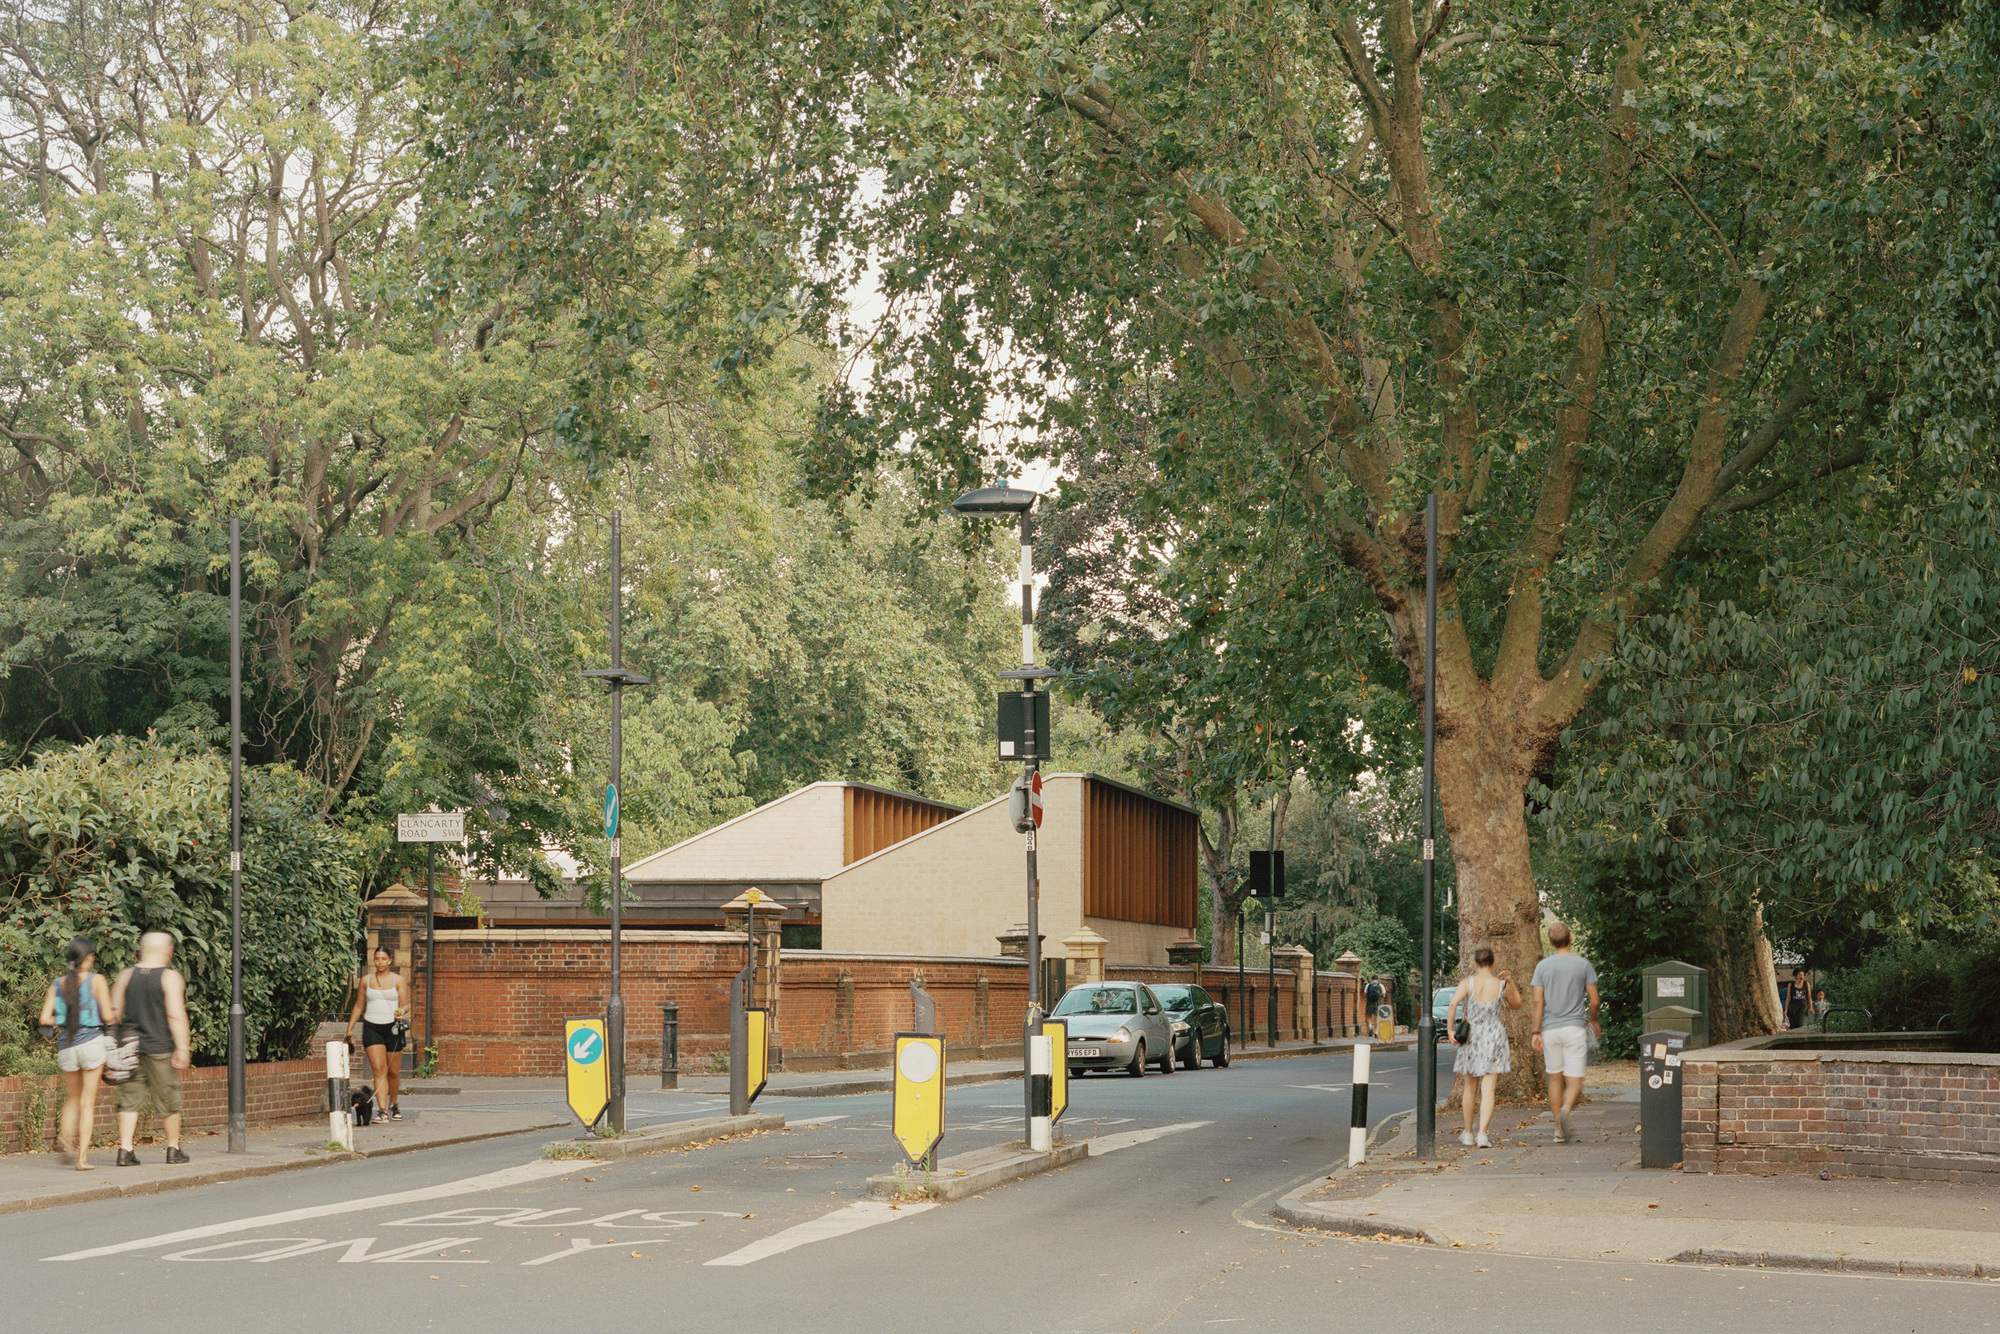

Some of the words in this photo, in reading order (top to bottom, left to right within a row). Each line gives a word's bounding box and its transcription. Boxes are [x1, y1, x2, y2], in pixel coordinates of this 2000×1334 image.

[400, 819, 461, 828] CLANCARTY
[400, 829, 428, 838] ROAD
[442, 829, 461, 838] SW6
[378, 1207, 742, 1229] BUS
[160, 1237, 671, 1266] ONLY
